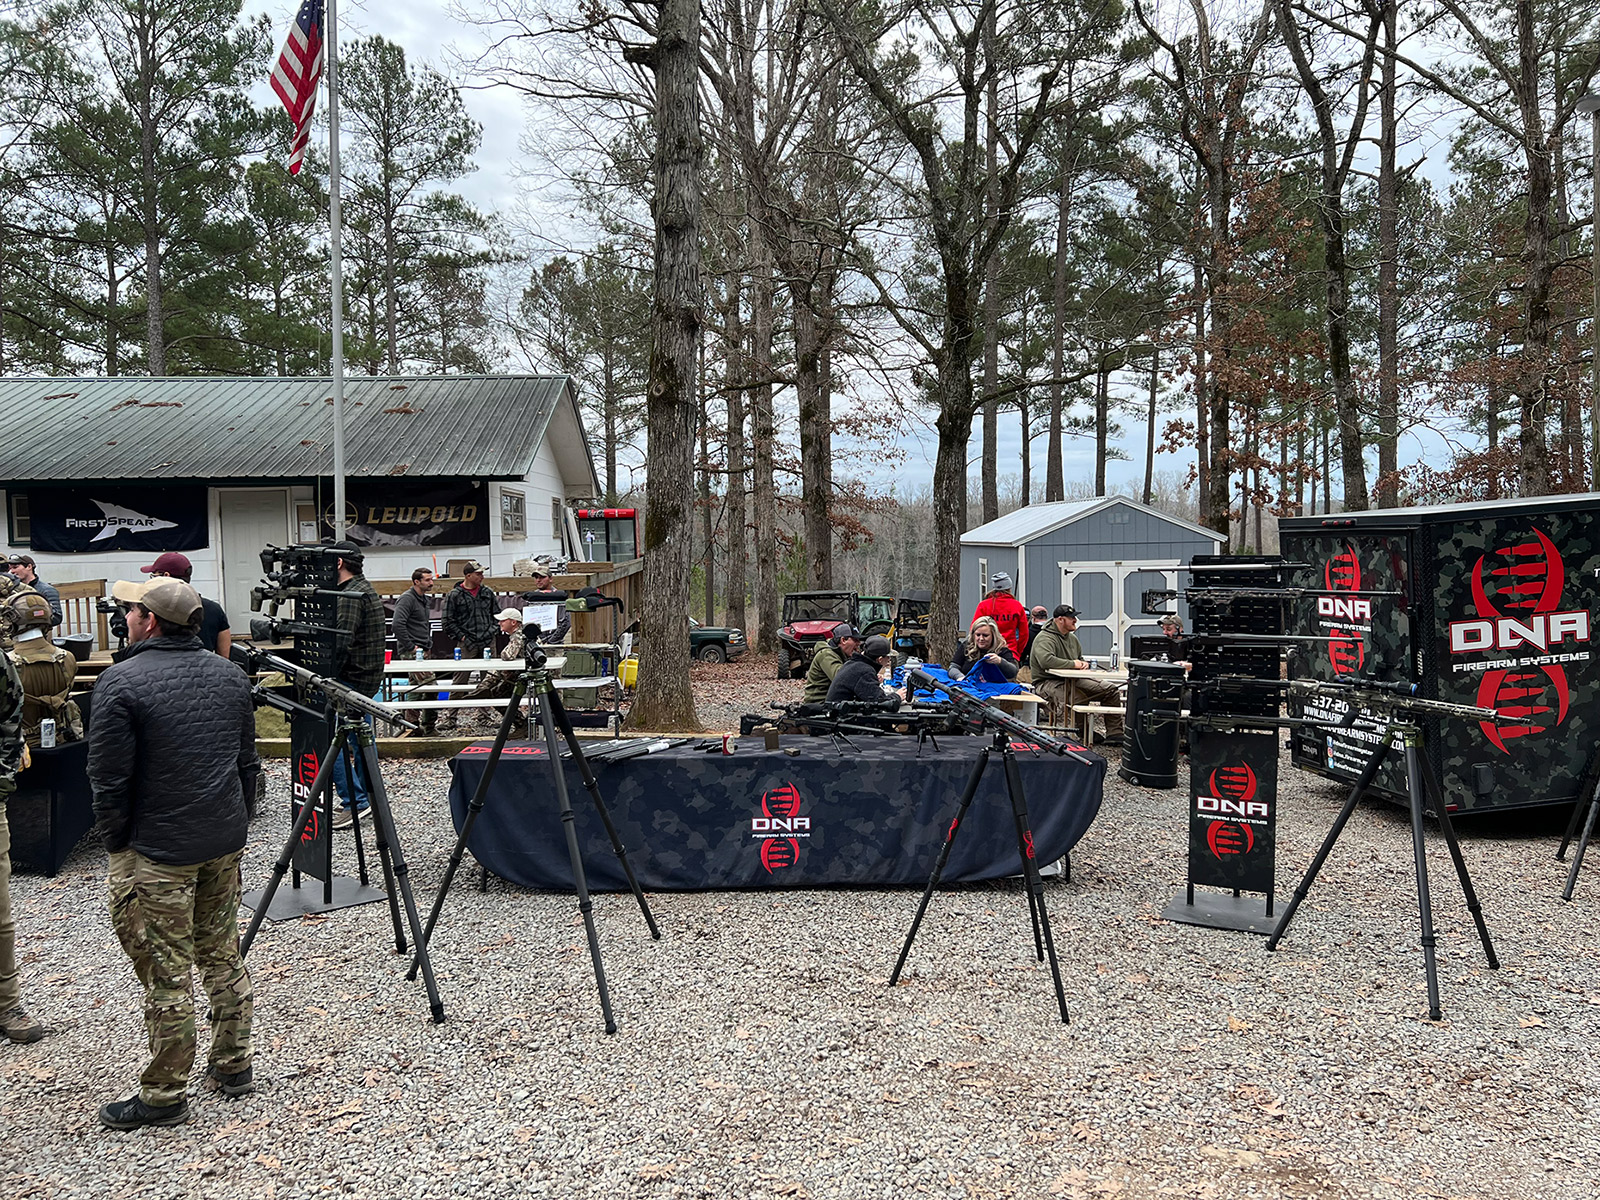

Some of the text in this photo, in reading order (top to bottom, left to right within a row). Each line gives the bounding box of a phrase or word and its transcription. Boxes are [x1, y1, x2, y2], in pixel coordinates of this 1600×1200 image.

[367, 505, 477, 524] LEUPOLD
[1318, 596, 1371, 623] DNA
[1449, 610, 1590, 654] DNA
[1452, 652, 1590, 673] FIREARM SYSTEMS
[1197, 796, 1268, 817] DNA
[752, 817, 811, 832] DNA
[1230, 817, 1268, 825] SYSTEMS
